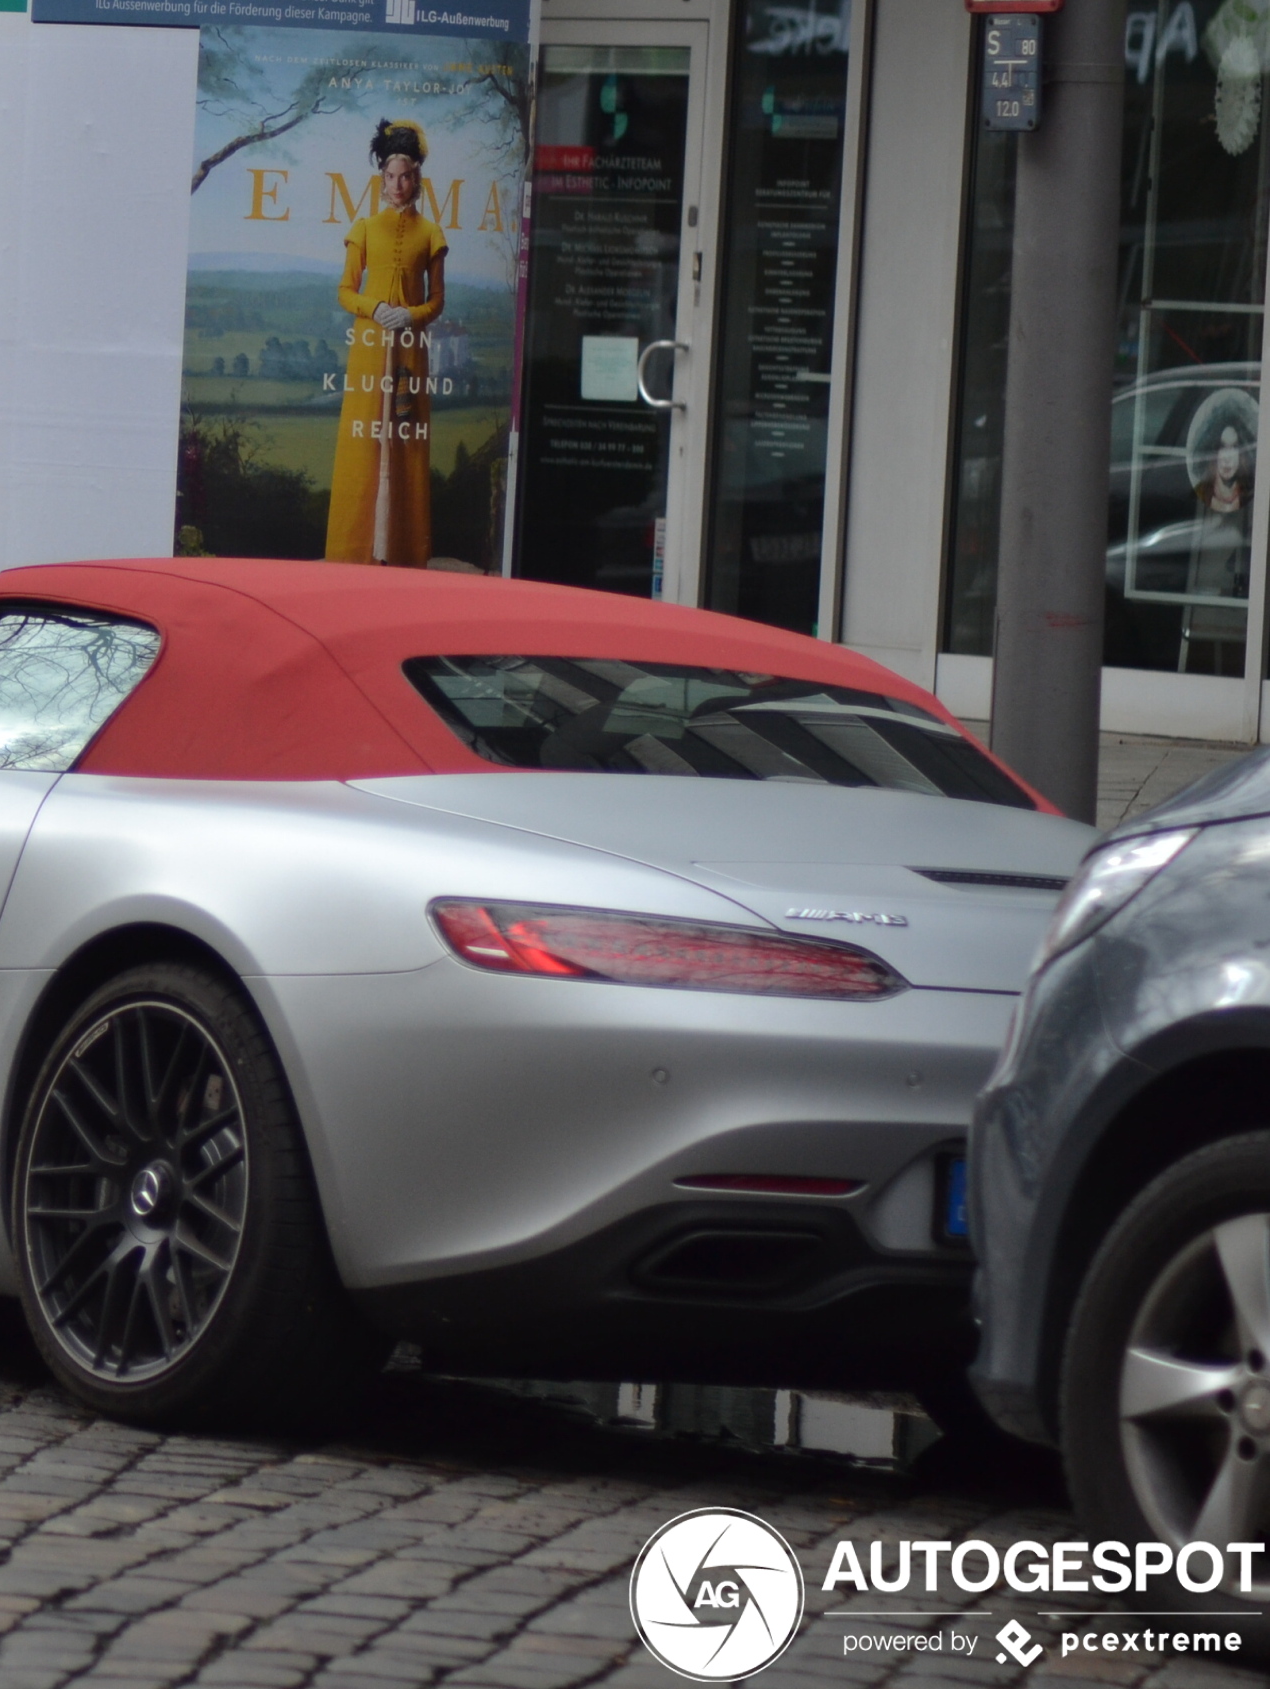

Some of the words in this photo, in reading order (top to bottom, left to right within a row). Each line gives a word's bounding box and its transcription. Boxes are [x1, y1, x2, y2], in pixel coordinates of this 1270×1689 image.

[113, 0, 190, 16] Aussenwerbung
[193, 2, 207, 13] für
[210, 2, 226, 14] die
[229, 3, 282, 20] Förderung
[285, 6, 315, 19] dieser
[318, 8, 373, 24] Kampagne.
[416, 10, 510, 32] ILG-Außenwerbung
[987, 30, 1001, 55] S
[1021, 39, 1036, 56] 80
[255, 55, 282, 63] NACH
[287, 56, 308, 64] DEM
[314, 57, 367, 67] ZEITLOSEN
[371, 60, 419, 70] KLASSIKER
[423, 63, 439, 71] VON
[328, 76, 373, 90] ANYA
[384, 79, 472, 95] TAYLOR-JOY
[345, 327, 432, 349] SCHÖN
[323, 373, 394, 393] KLUG
[409, 376, 453, 395] UND
[352, 420, 428, 440] REICH
